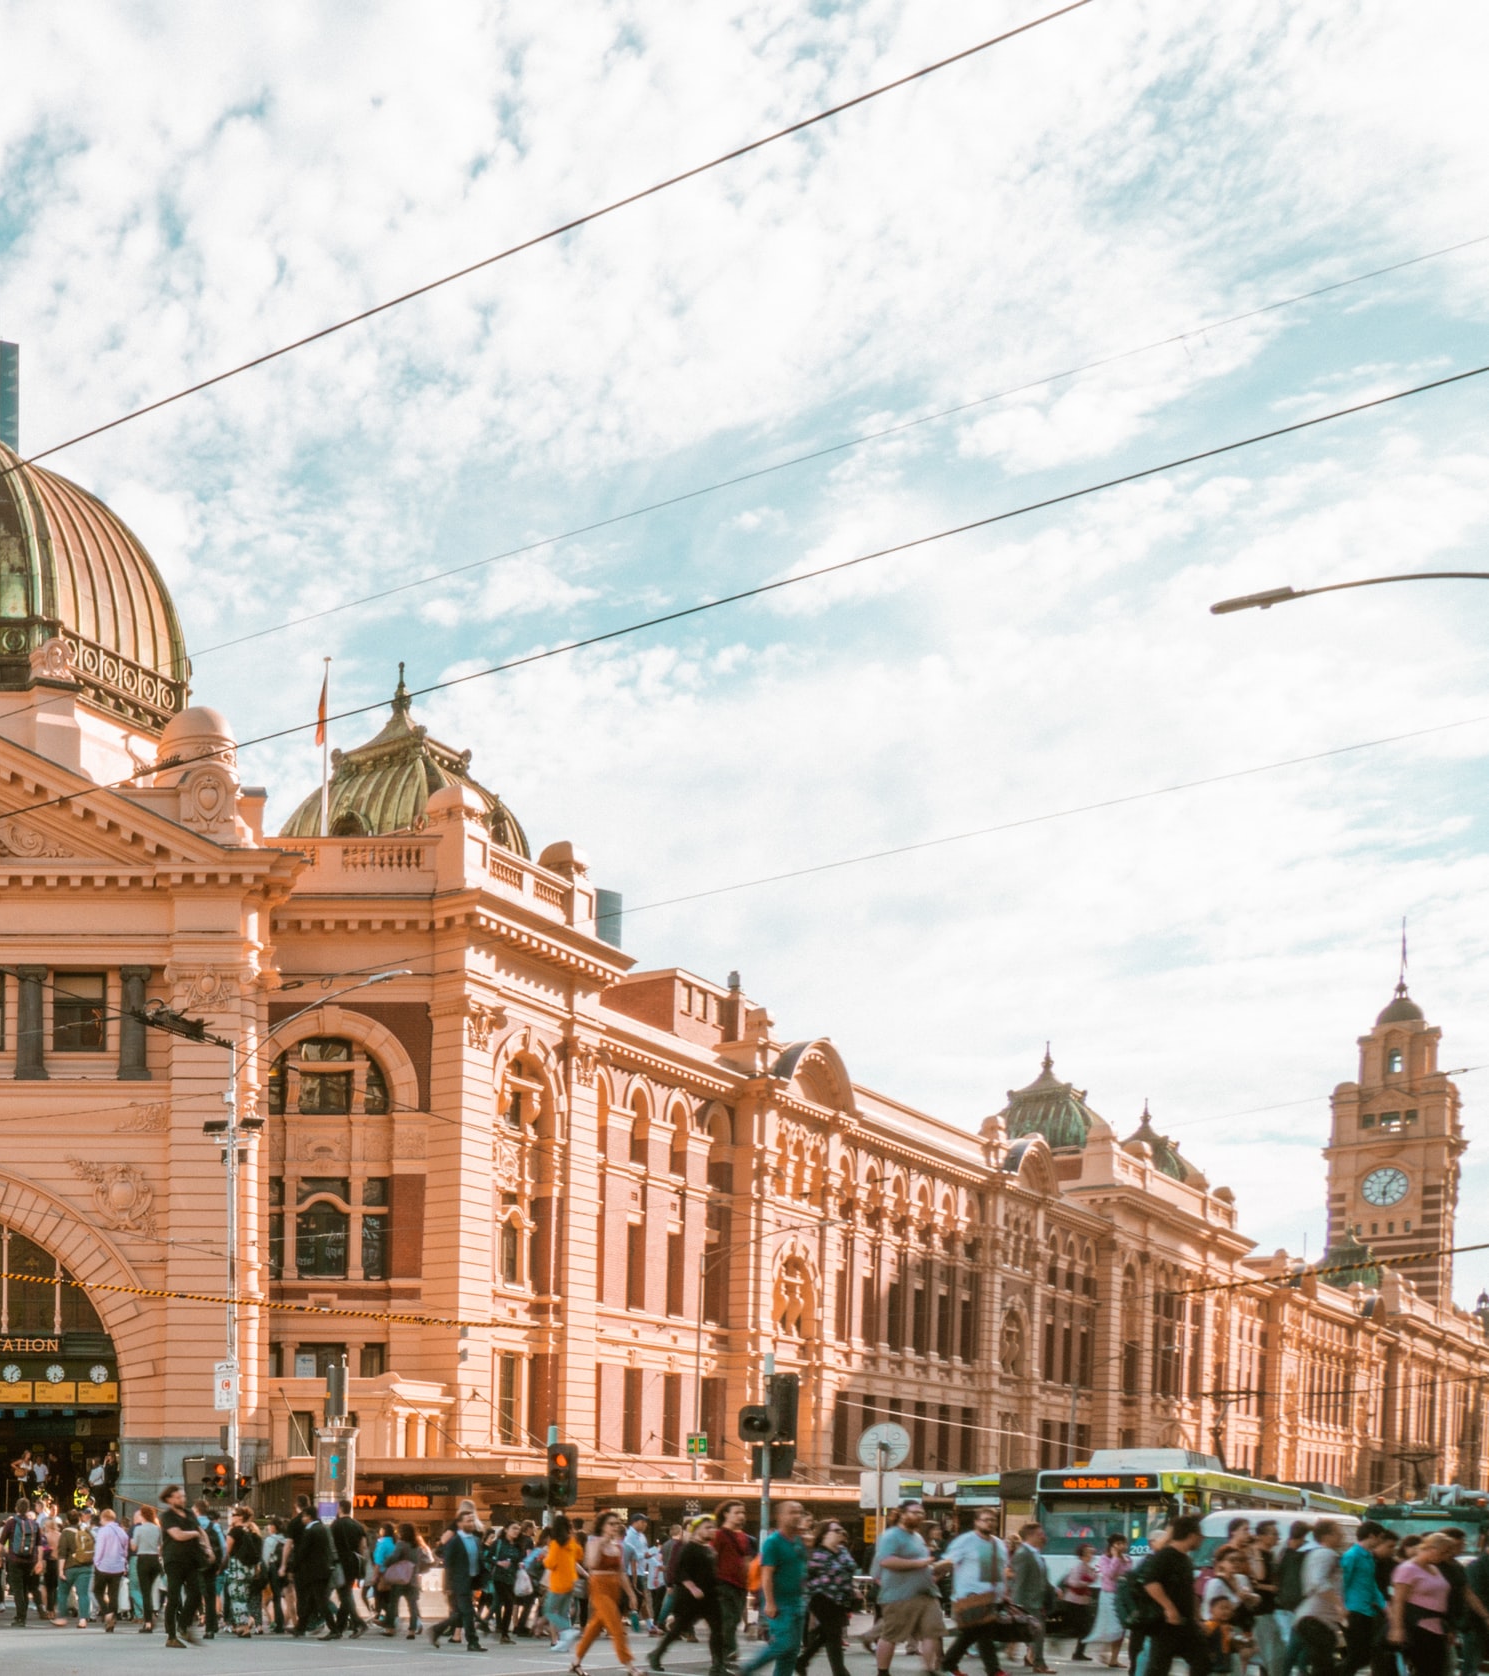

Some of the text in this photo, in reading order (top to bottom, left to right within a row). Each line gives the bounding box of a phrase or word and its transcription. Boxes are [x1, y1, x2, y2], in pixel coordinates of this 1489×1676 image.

[1078, 1477, 1106, 1488] Bridge
[1107, 1477, 1120, 1488] Rd
[1135, 1477, 1148, 1488] 75
[352, 1495, 429, 1508] ITY HATTERS
